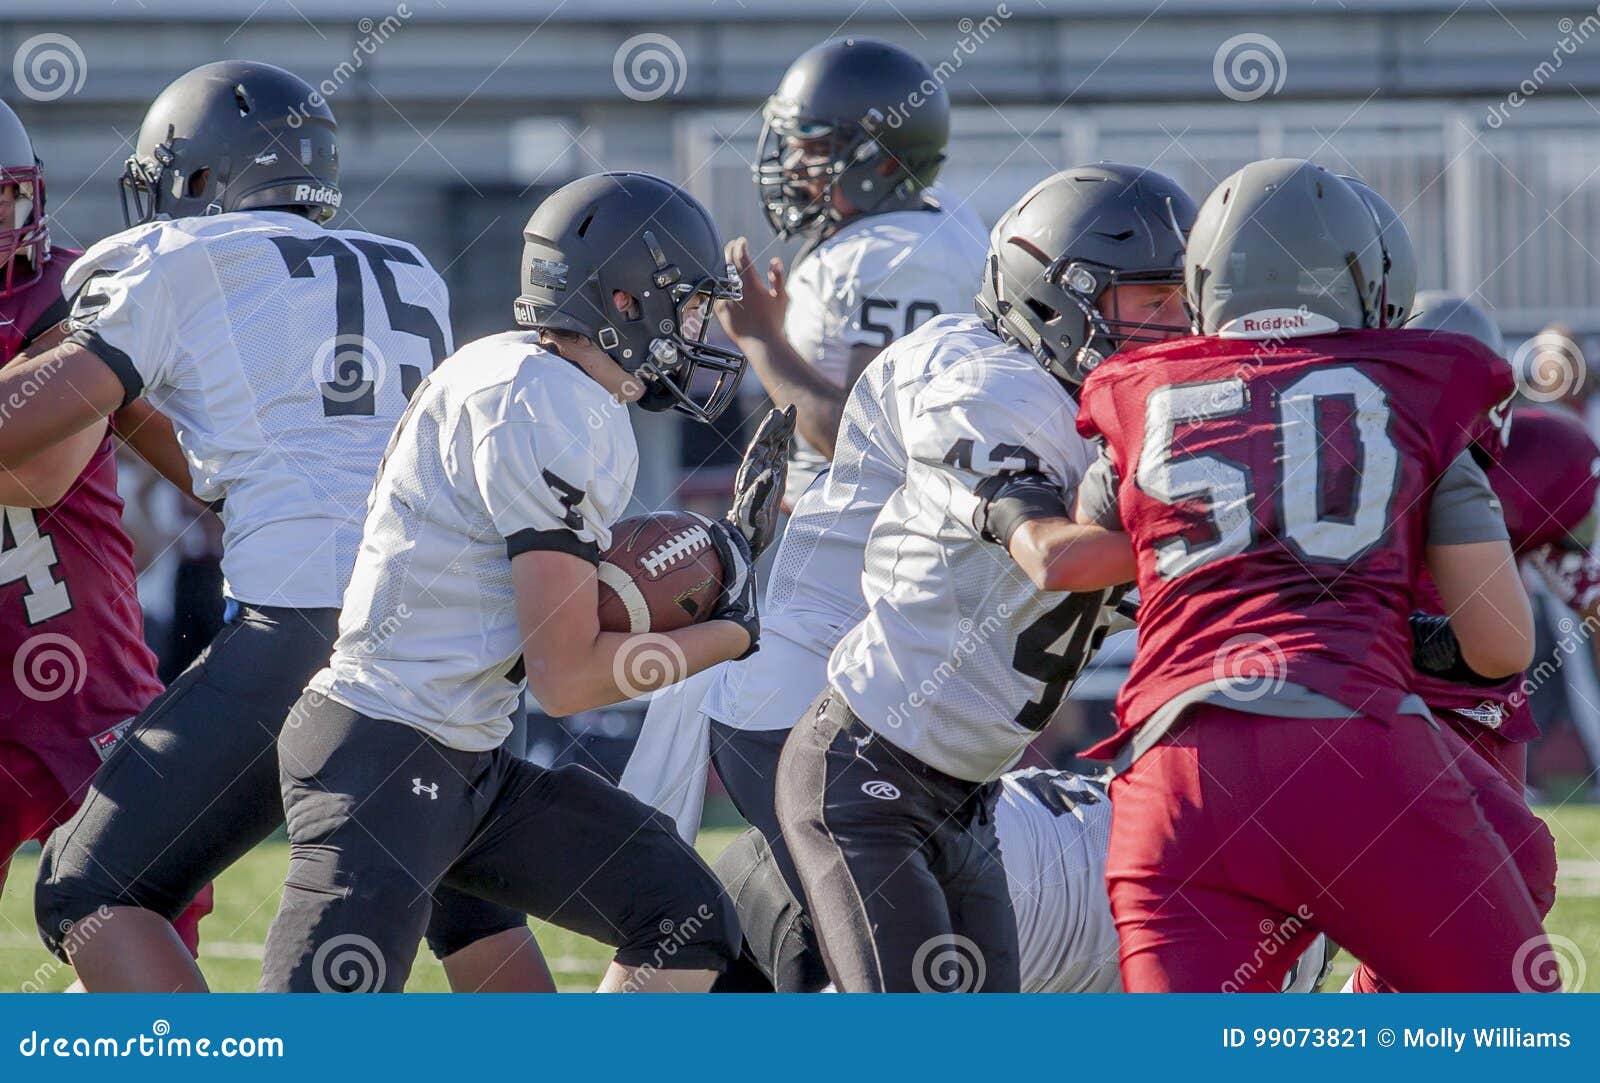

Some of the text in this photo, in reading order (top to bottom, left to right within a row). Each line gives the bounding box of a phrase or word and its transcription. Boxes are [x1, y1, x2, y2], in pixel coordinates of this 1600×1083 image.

[295, 185, 342, 207] Riddel
[267, 236, 454, 417] 75
[1136, 364, 1399, 582] 50
[1012, 579, 1139, 732] 4
